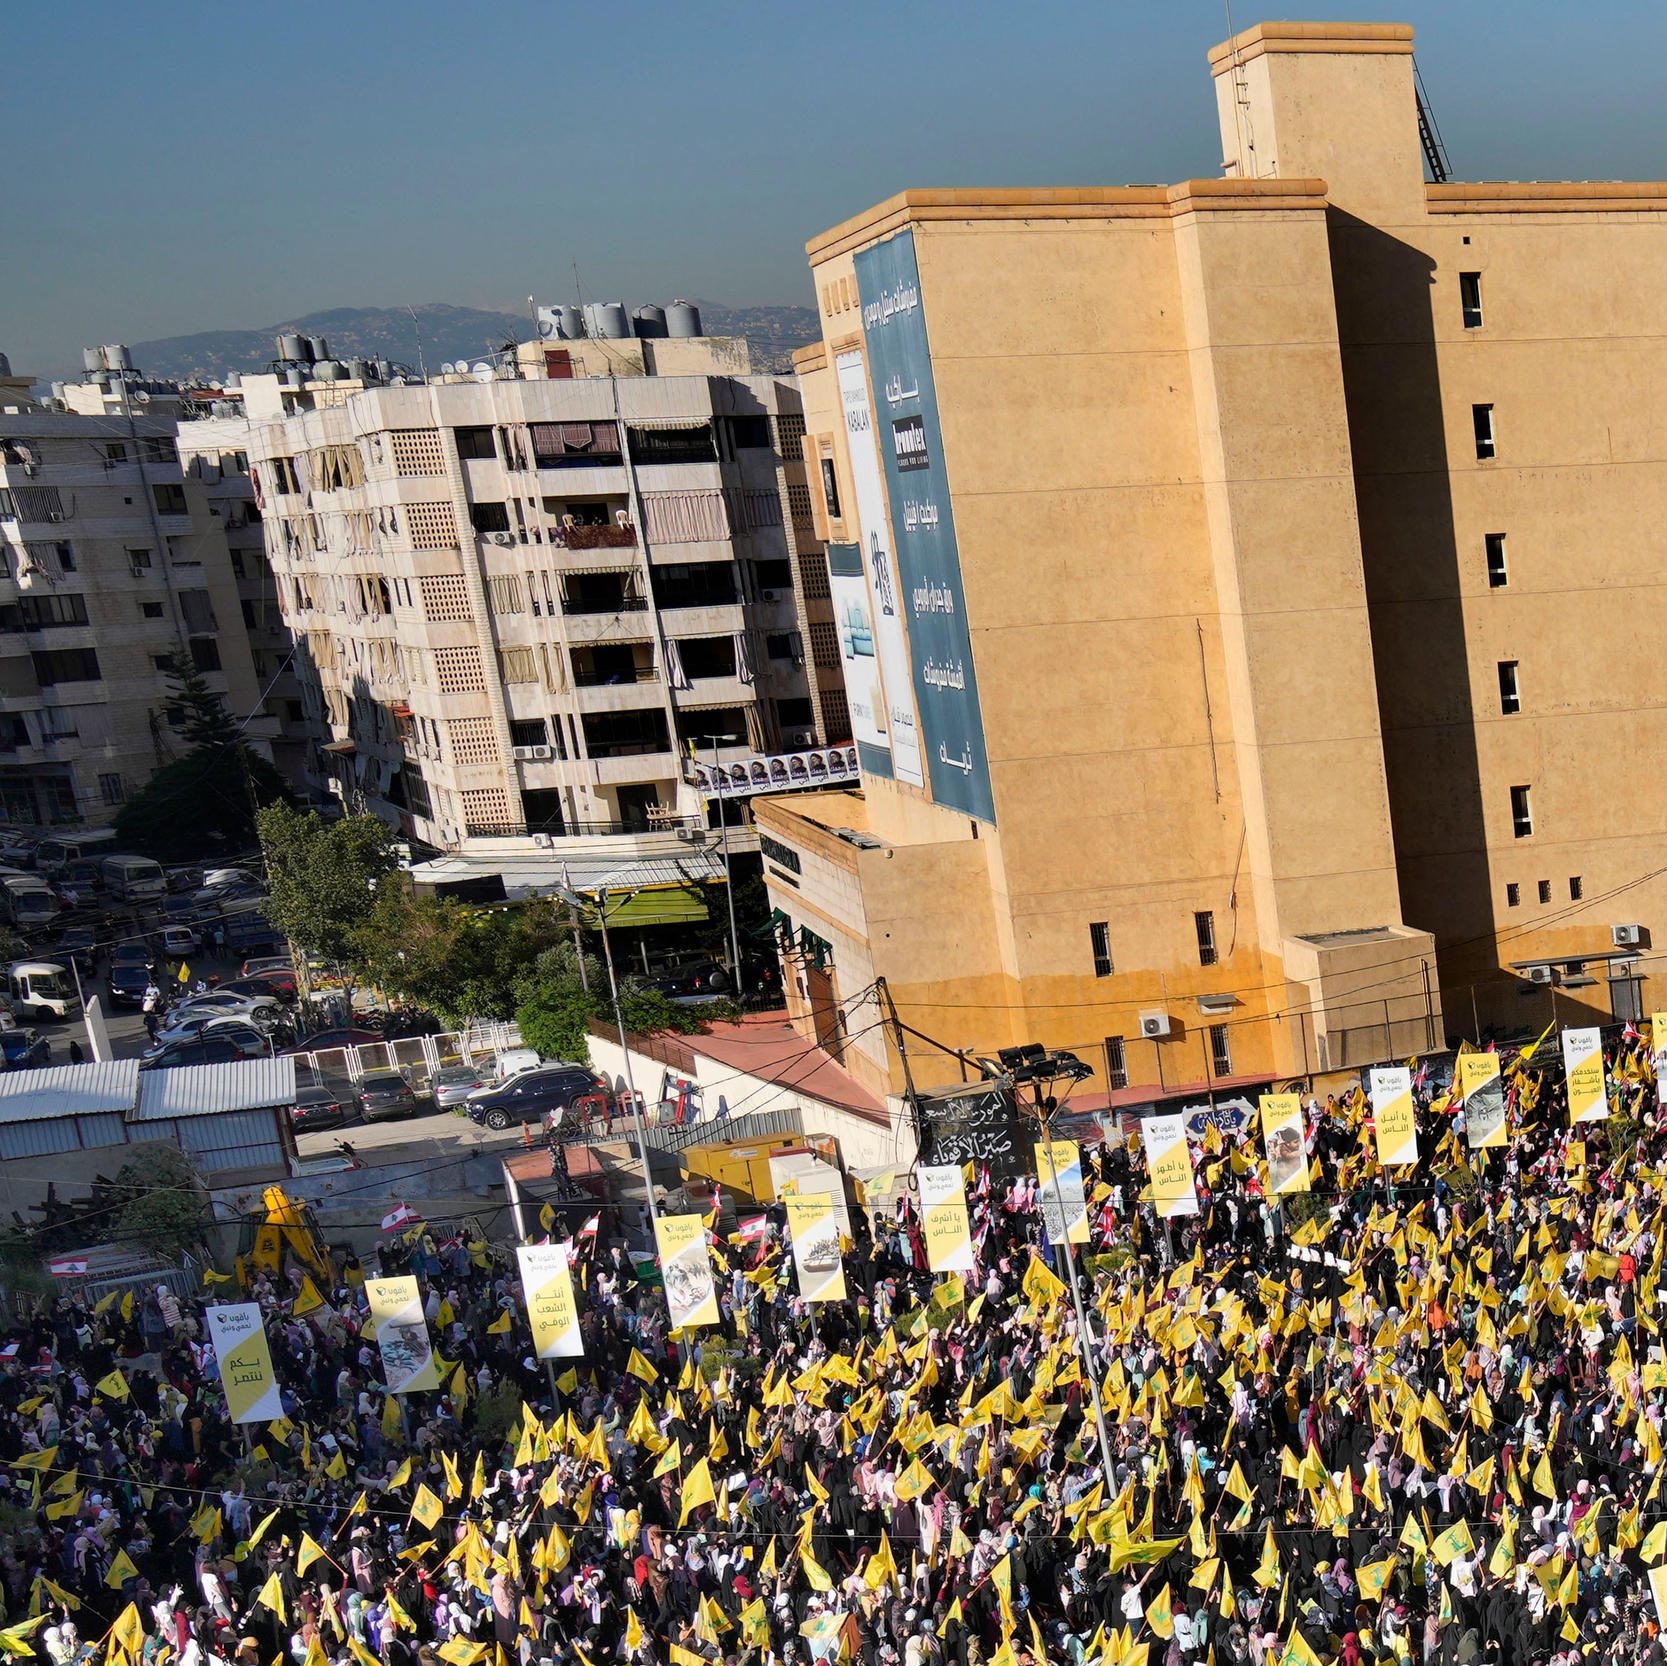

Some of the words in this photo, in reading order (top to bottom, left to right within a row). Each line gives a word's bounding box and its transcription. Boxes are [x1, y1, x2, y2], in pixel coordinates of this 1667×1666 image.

[1383, 1124, 1408, 1134] الناس
[1159, 1175, 1186, 1185] الناس
[933, 1226, 962, 1237] الناس
[229, 1312, 250, 1323] باقون
[230, 1357, 260, 1370] بكم
